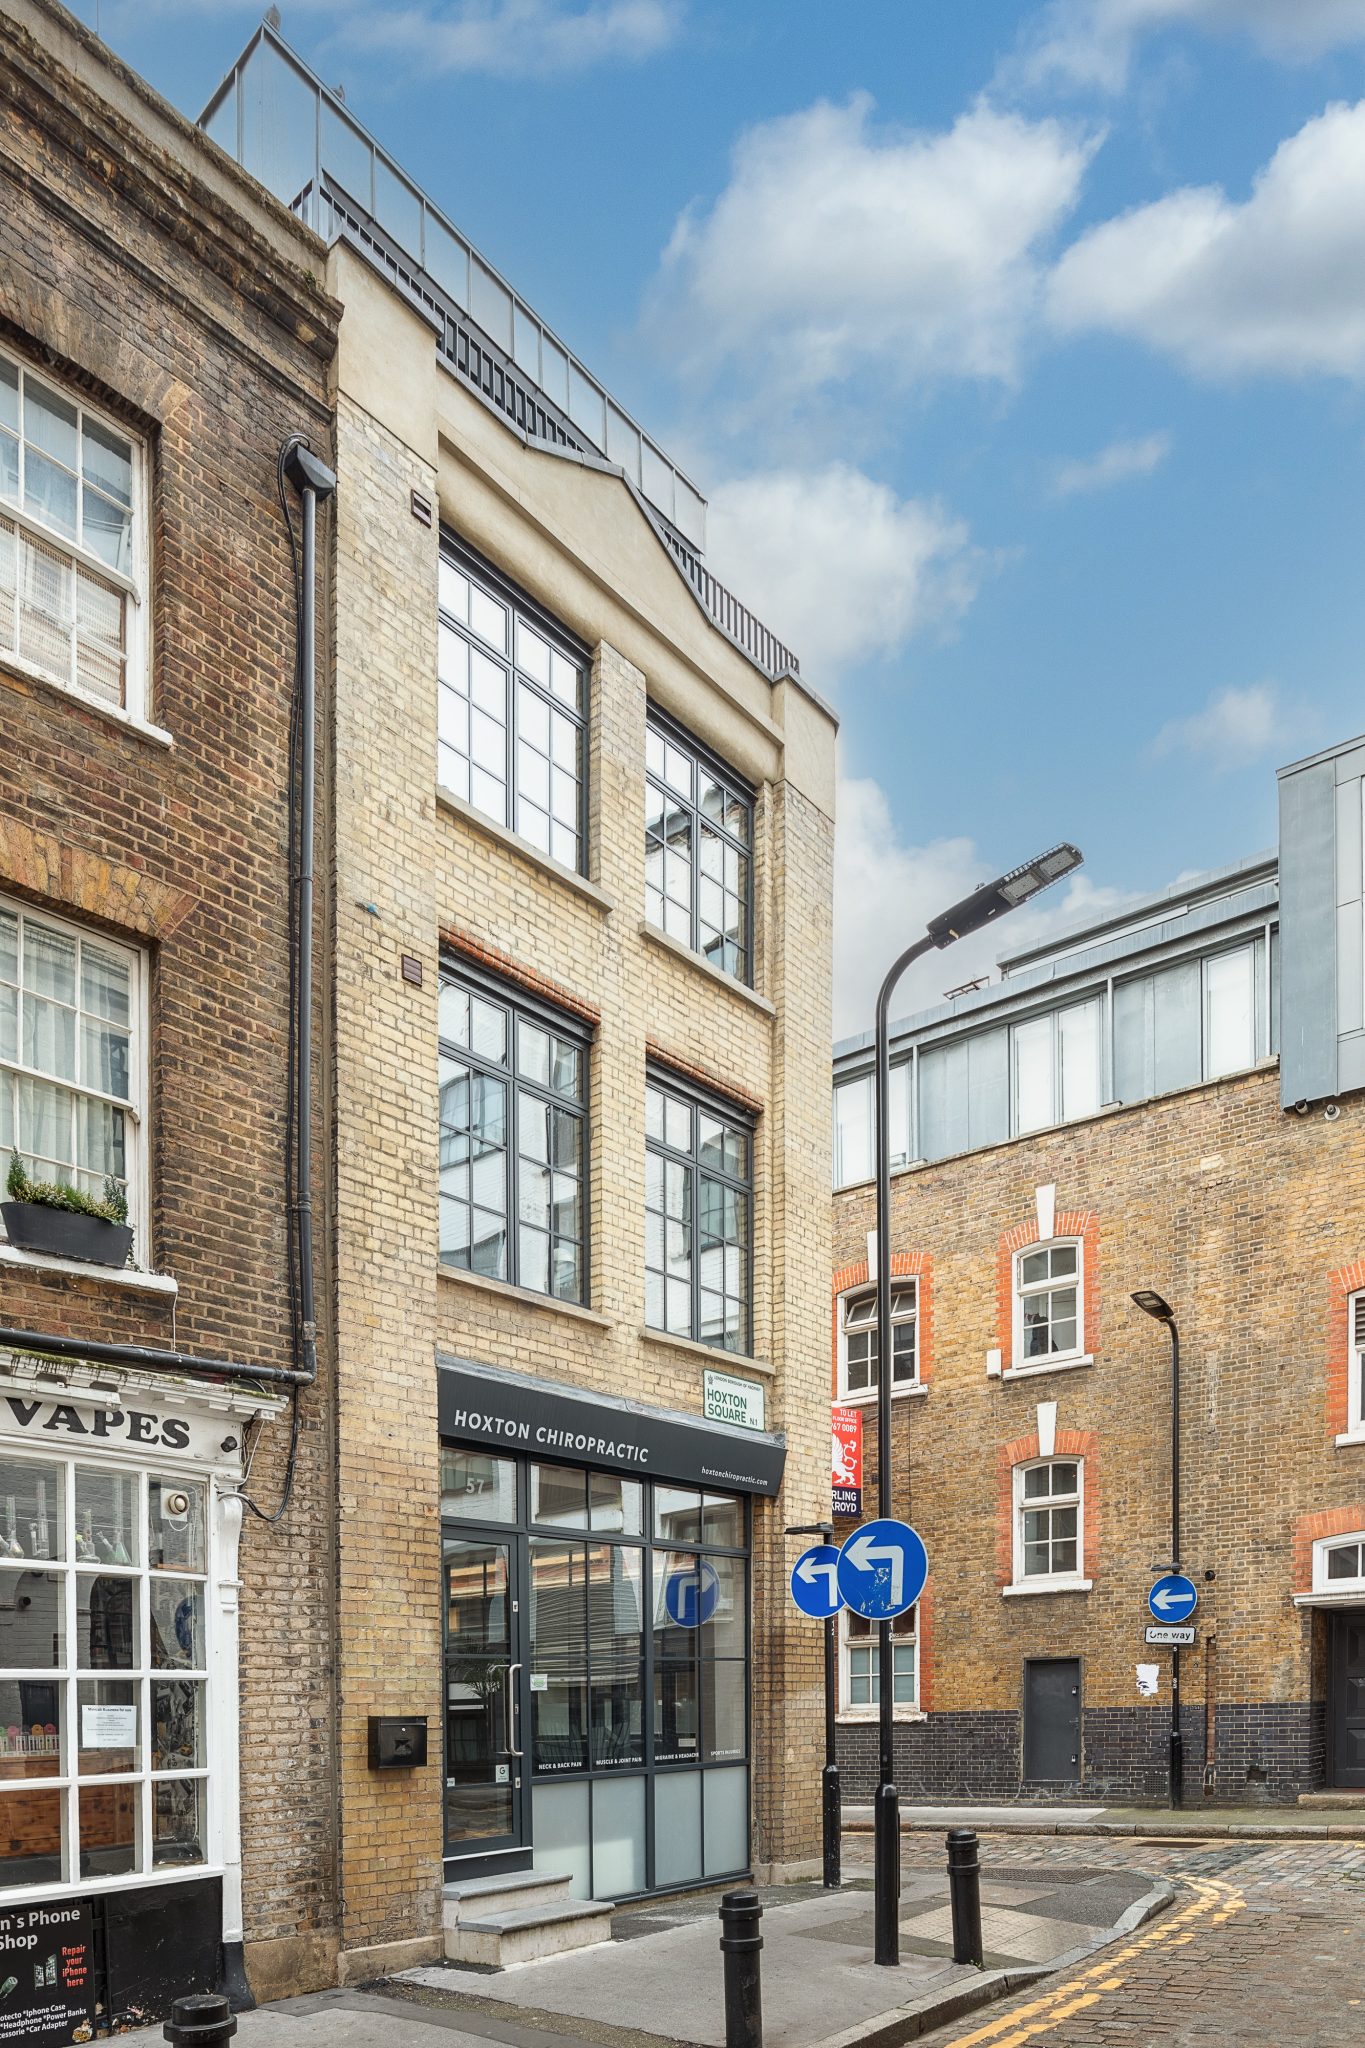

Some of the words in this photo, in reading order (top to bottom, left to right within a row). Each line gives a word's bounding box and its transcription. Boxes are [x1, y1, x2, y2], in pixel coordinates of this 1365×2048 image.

[708, 1388, 747, 1409] HOXTON
[708, 1403, 746, 1423] SQUARE
[848, 1410, 857, 1418] LET
[5, 1397, 190, 1449] VAPES
[842, 1424, 856, 1432] 0089
[454, 1410, 530, 1440] HOXTON
[536, 1426, 649, 1463] CHIROPRACTIC
[702, 1466, 768, 1486] hoxtonchiropractic.com
[466, 1477, 484, 1495] 57
[1150, 1630, 1168, 1639] One
[29, 1910, 80, 1926] Phone
[62, 1944, 86, 1956] Repair
[66, 1957, 83, 1967] your
[62, 1967, 87, 1977] iPhone
[67, 1978, 83, 1987] here
[50, 2004, 66, 2012] Case
[68, 2008, 86, 2017] Banks
[42, 2020, 68, 2031] Adapter
